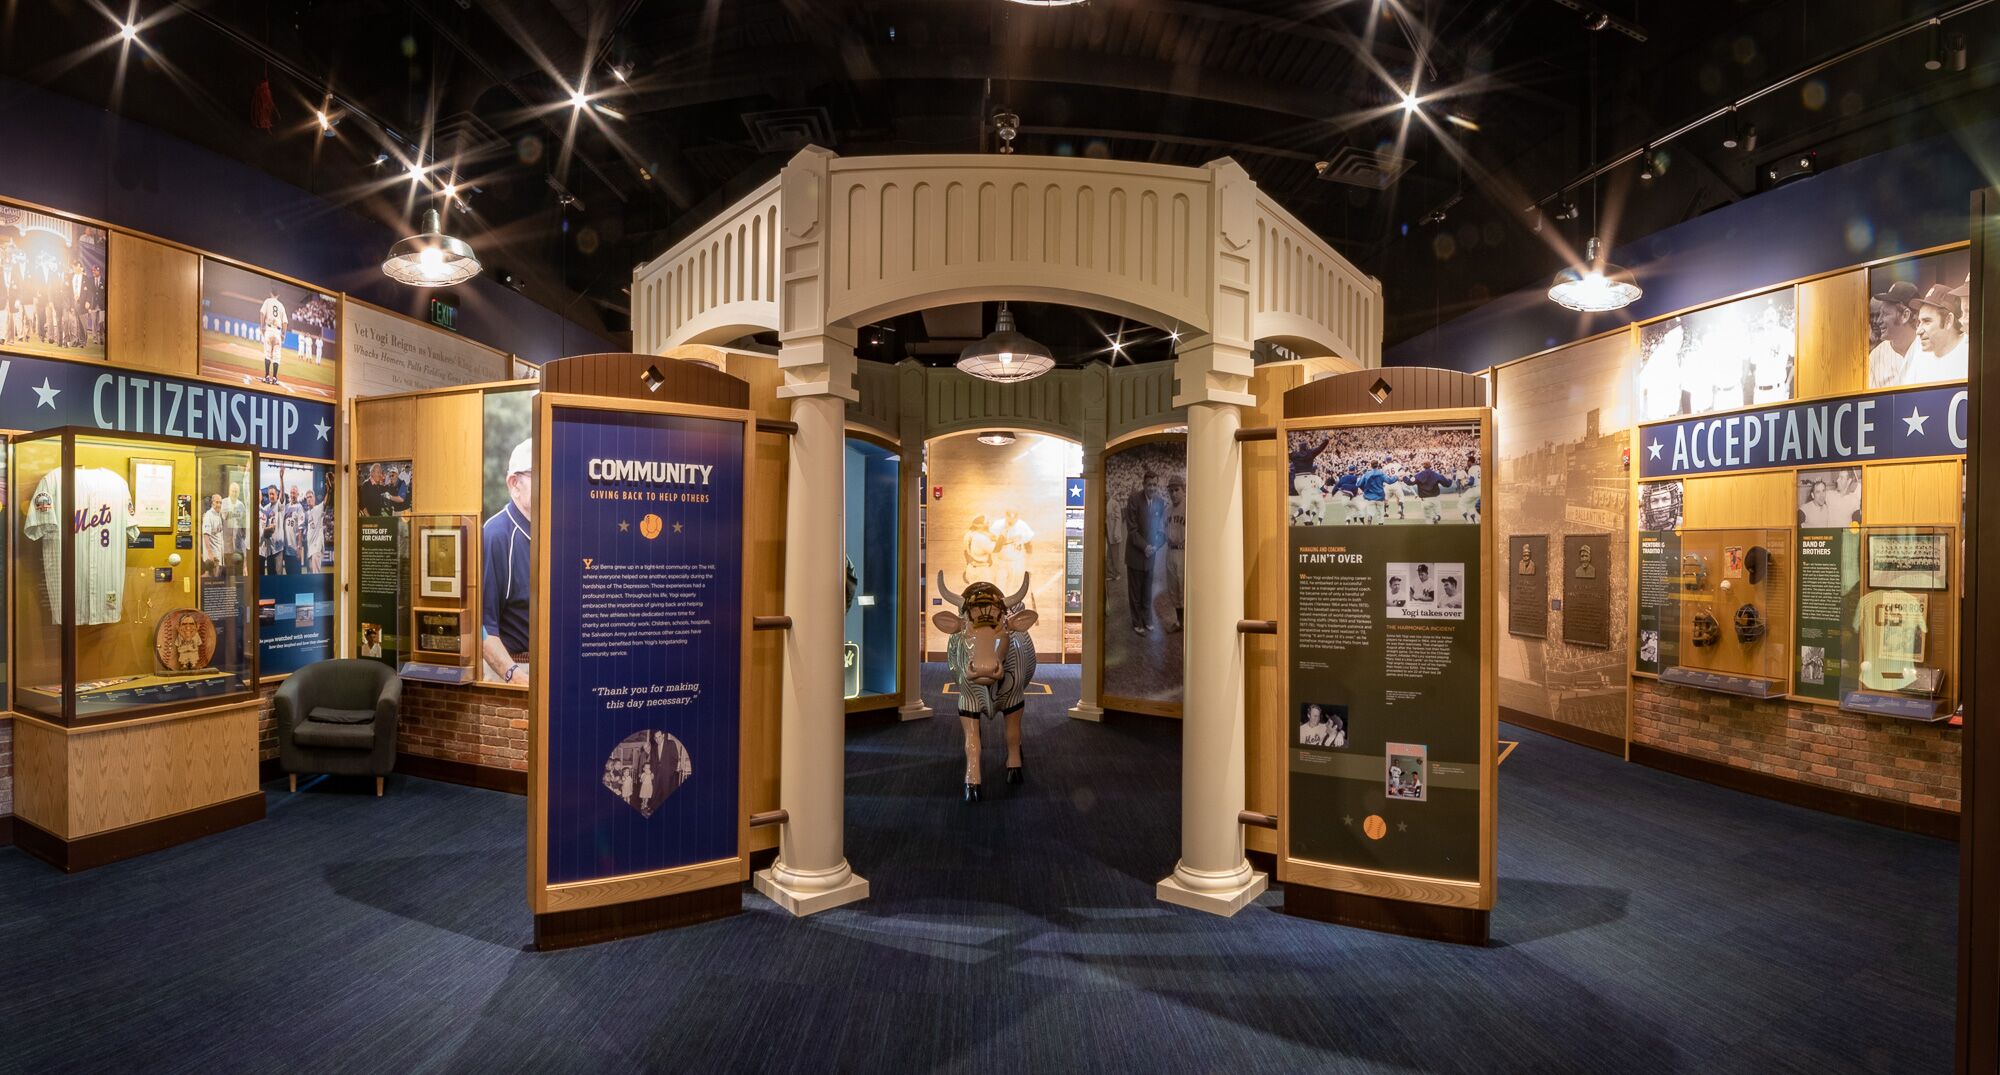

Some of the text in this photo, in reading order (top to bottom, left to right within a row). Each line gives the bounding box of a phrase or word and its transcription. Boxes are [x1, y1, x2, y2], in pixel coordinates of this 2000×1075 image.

[272, 305, 278, 318] 8
[436, 302, 454, 326] EXIT
[354, 322, 368, 338] Vet
[370, 328, 388, 346] Yogi
[391, 335, 416, 354] Reigns
[94, 374, 298, 450] CITIZENSHIP
[1672, 400, 1875, 470] ACCEPTANCE
[588, 458, 713, 485] COMMUNITY
[590, 490, 709, 503] GIVING BACK TO HELP OTHERS
[75, 504, 111, 533] Mets
[101, 529, 109, 548] 8
[583, 558, 599, 570] Yogi
[1300, 554, 1363, 563] IT AIN'T OVER
[1402, 609, 1419, 617] Yogi
[592, 686, 628, 696] "Thank
[630, 687, 648, 695] you
[650, 684, 663, 693] for
[626, 699, 644, 708] day
